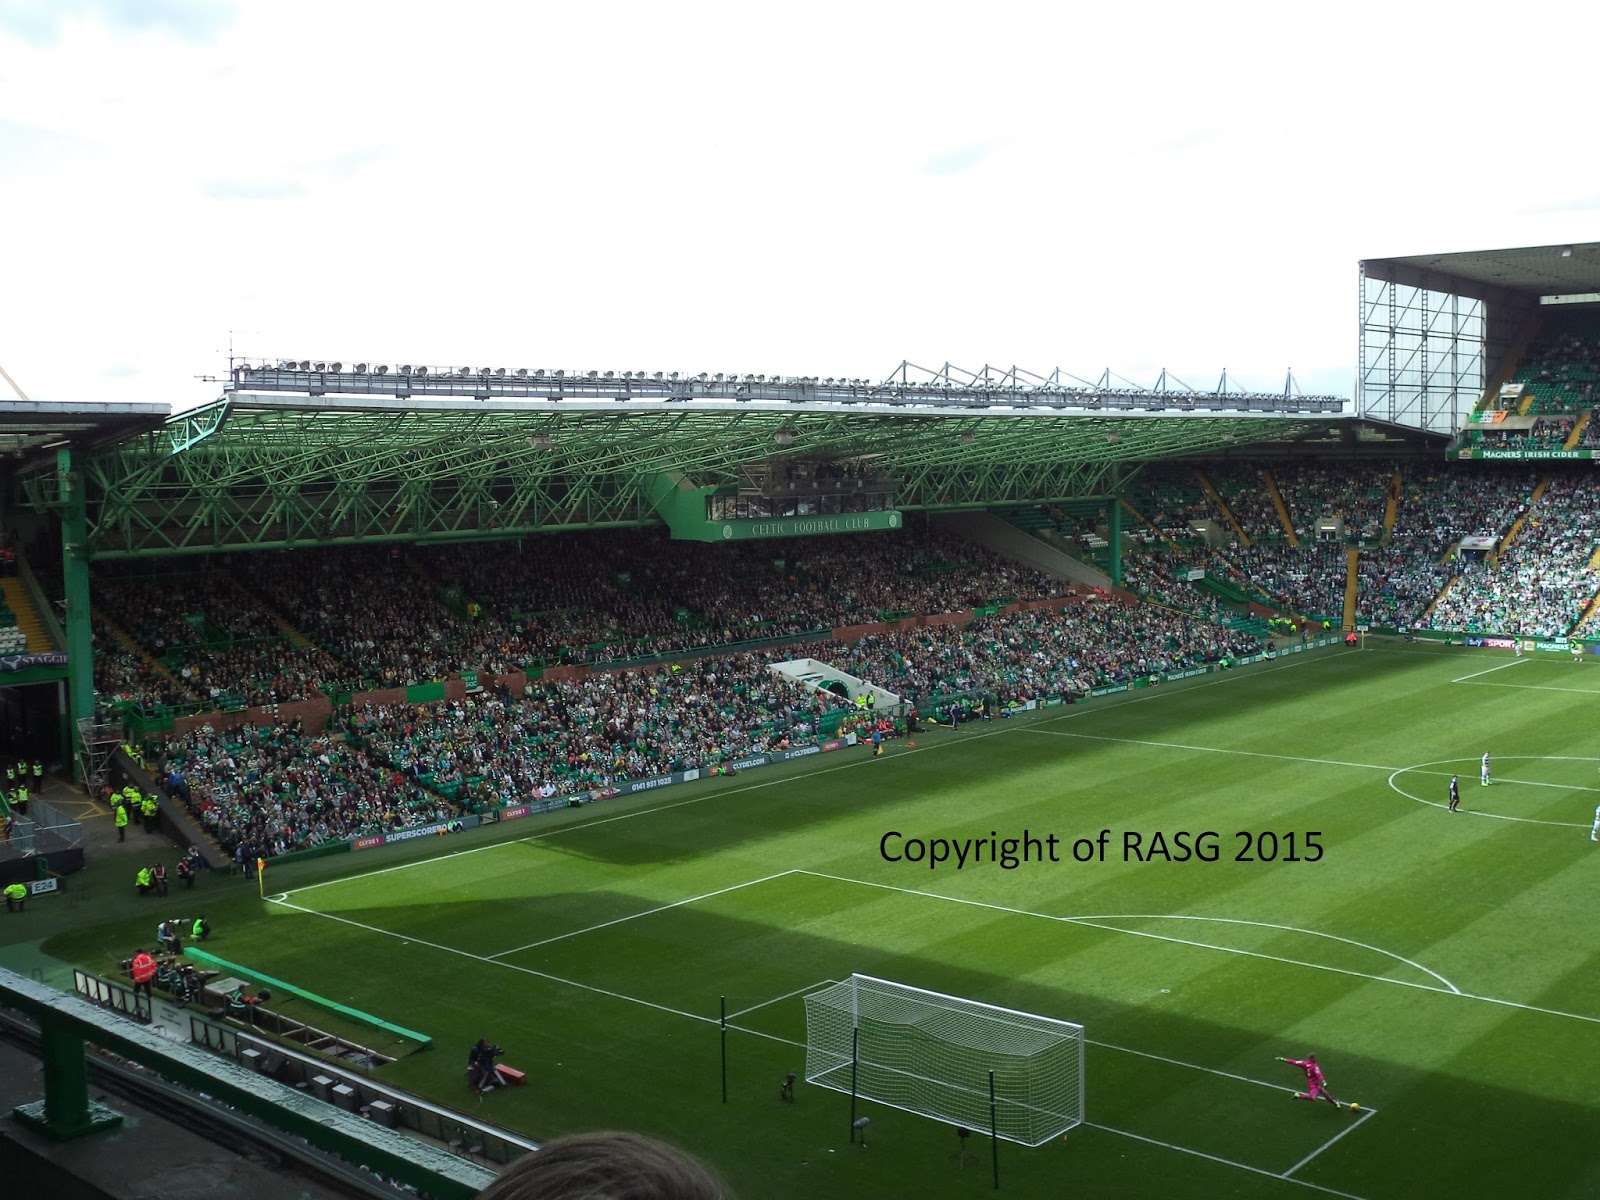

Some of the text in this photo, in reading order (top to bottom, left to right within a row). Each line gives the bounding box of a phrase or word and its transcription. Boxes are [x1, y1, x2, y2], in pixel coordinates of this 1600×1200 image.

[1483, 450, 1521, 458] MAGNERS
[752, 518, 870, 535] CELTIC FOOTBALL CLUB
[1488, 639, 1522, 649] SPORT
[1536, 642, 1569, 650] MAGNERS
[35, 881, 53, 891] E24
